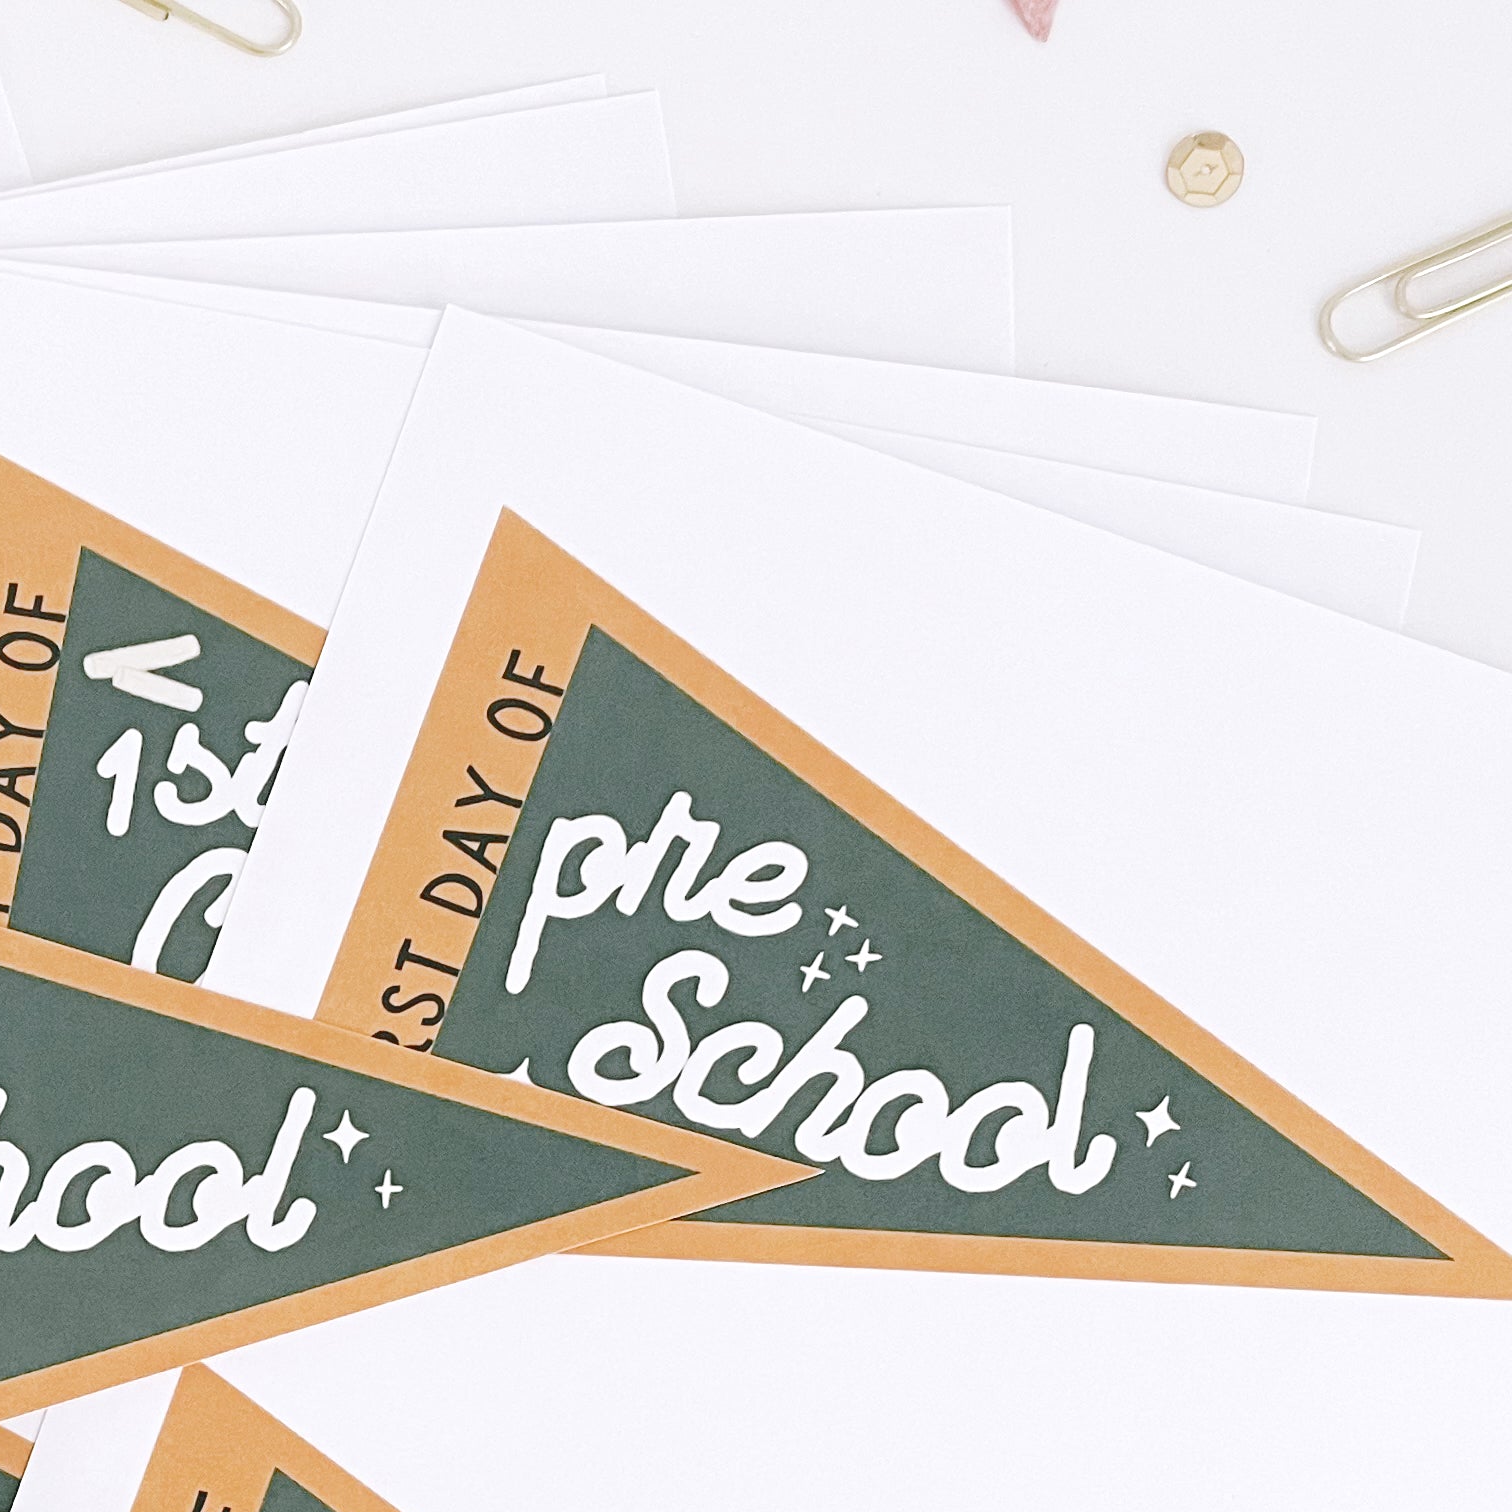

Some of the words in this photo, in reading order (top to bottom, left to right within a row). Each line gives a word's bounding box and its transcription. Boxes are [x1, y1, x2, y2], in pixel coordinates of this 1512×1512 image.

[420, 765, 524, 920] DAY
[488, 648, 565, 744] OF
[507, 790, 810, 995] pre
[568, 949, 1117, 1195] School
